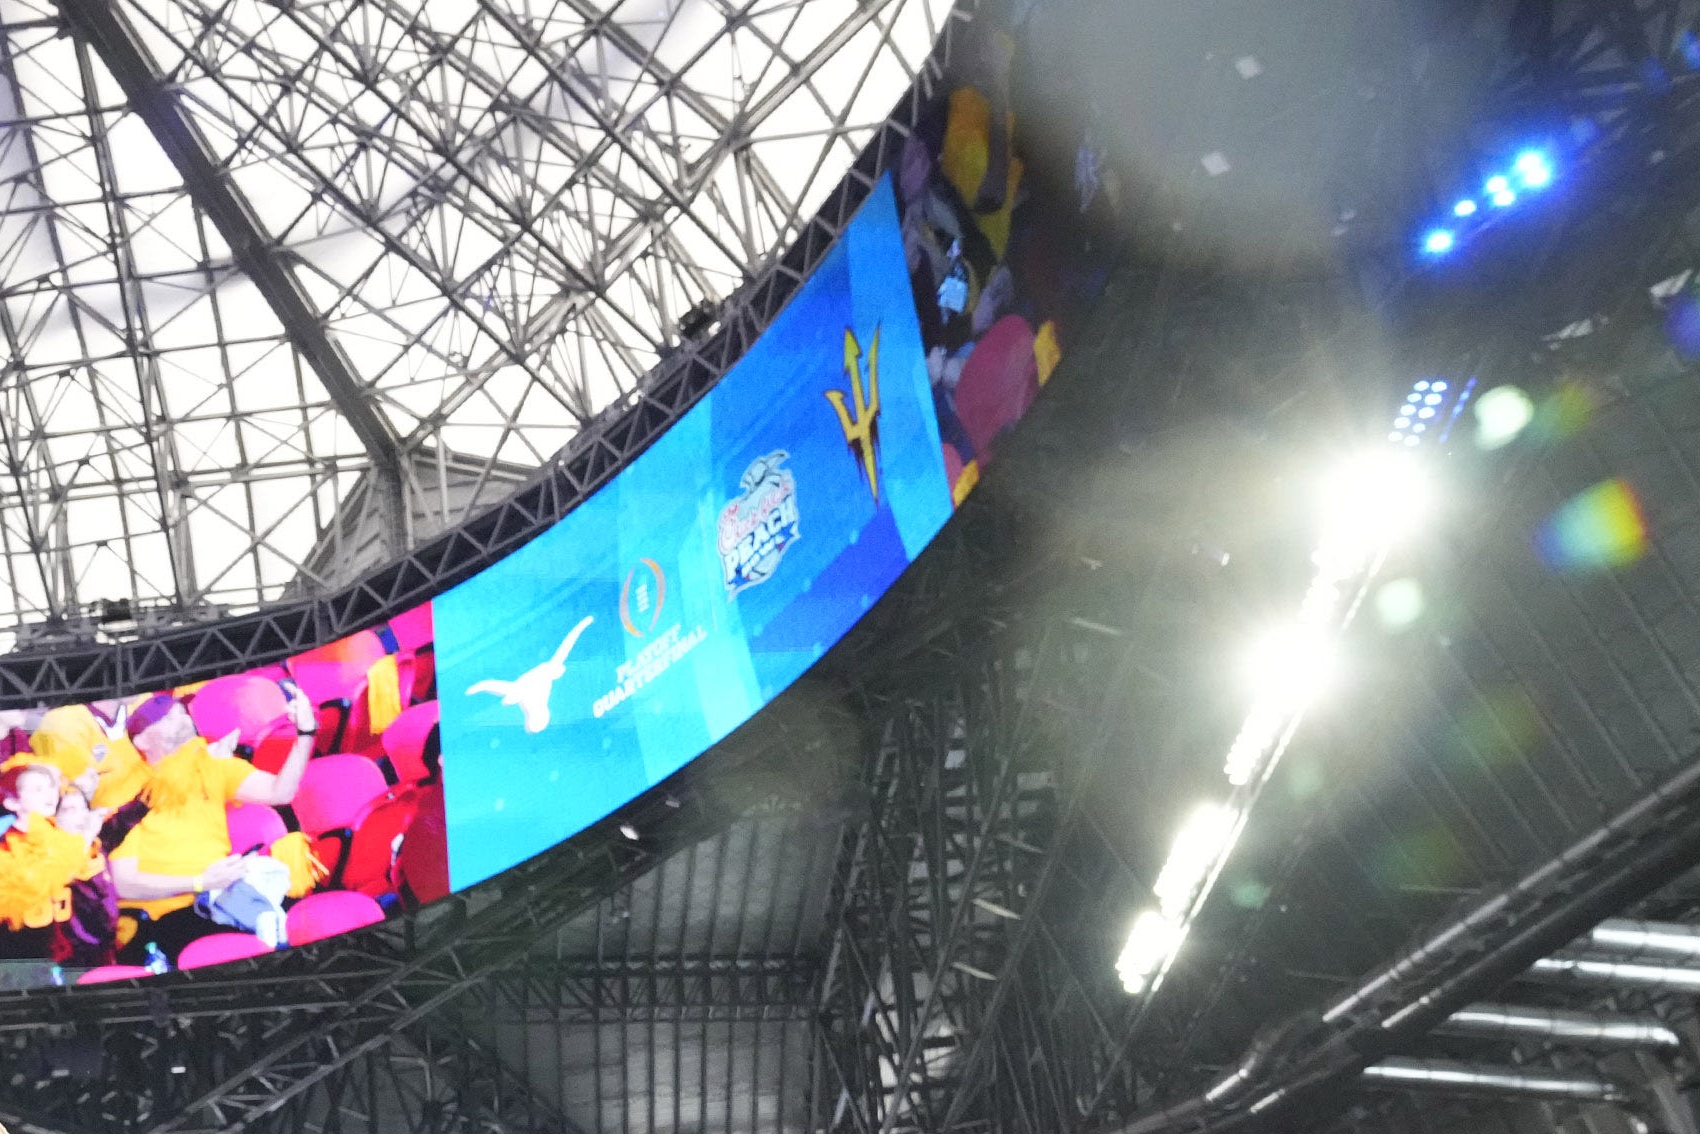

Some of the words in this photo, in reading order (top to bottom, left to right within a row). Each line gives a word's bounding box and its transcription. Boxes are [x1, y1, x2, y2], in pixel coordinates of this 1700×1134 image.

[724, 493, 796, 585] PEACH
[593, 625, 707, 718] QUARTERFINAL
[616, 623, 681, 683] PLAYOFF
